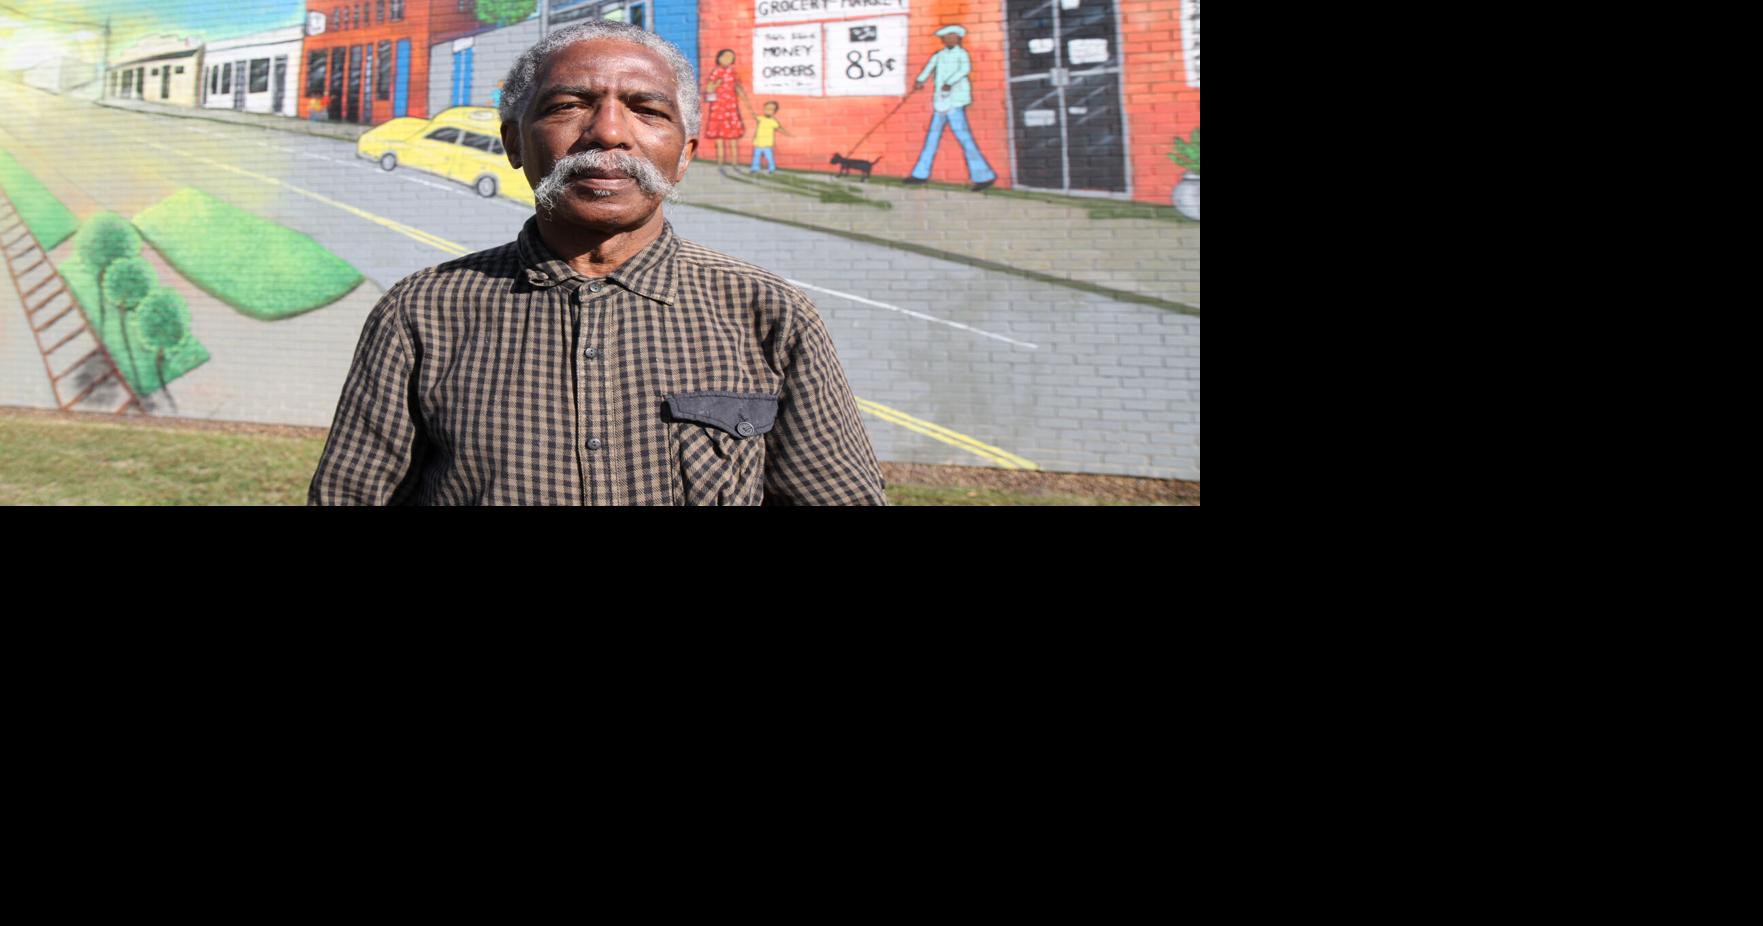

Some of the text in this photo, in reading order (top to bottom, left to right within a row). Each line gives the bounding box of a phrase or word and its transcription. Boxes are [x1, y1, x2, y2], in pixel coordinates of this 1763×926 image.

[763, 45, 814, 57] MONEY
[762, 64, 815, 78] ORDERS
[846, 49, 896, 80] 85¢
